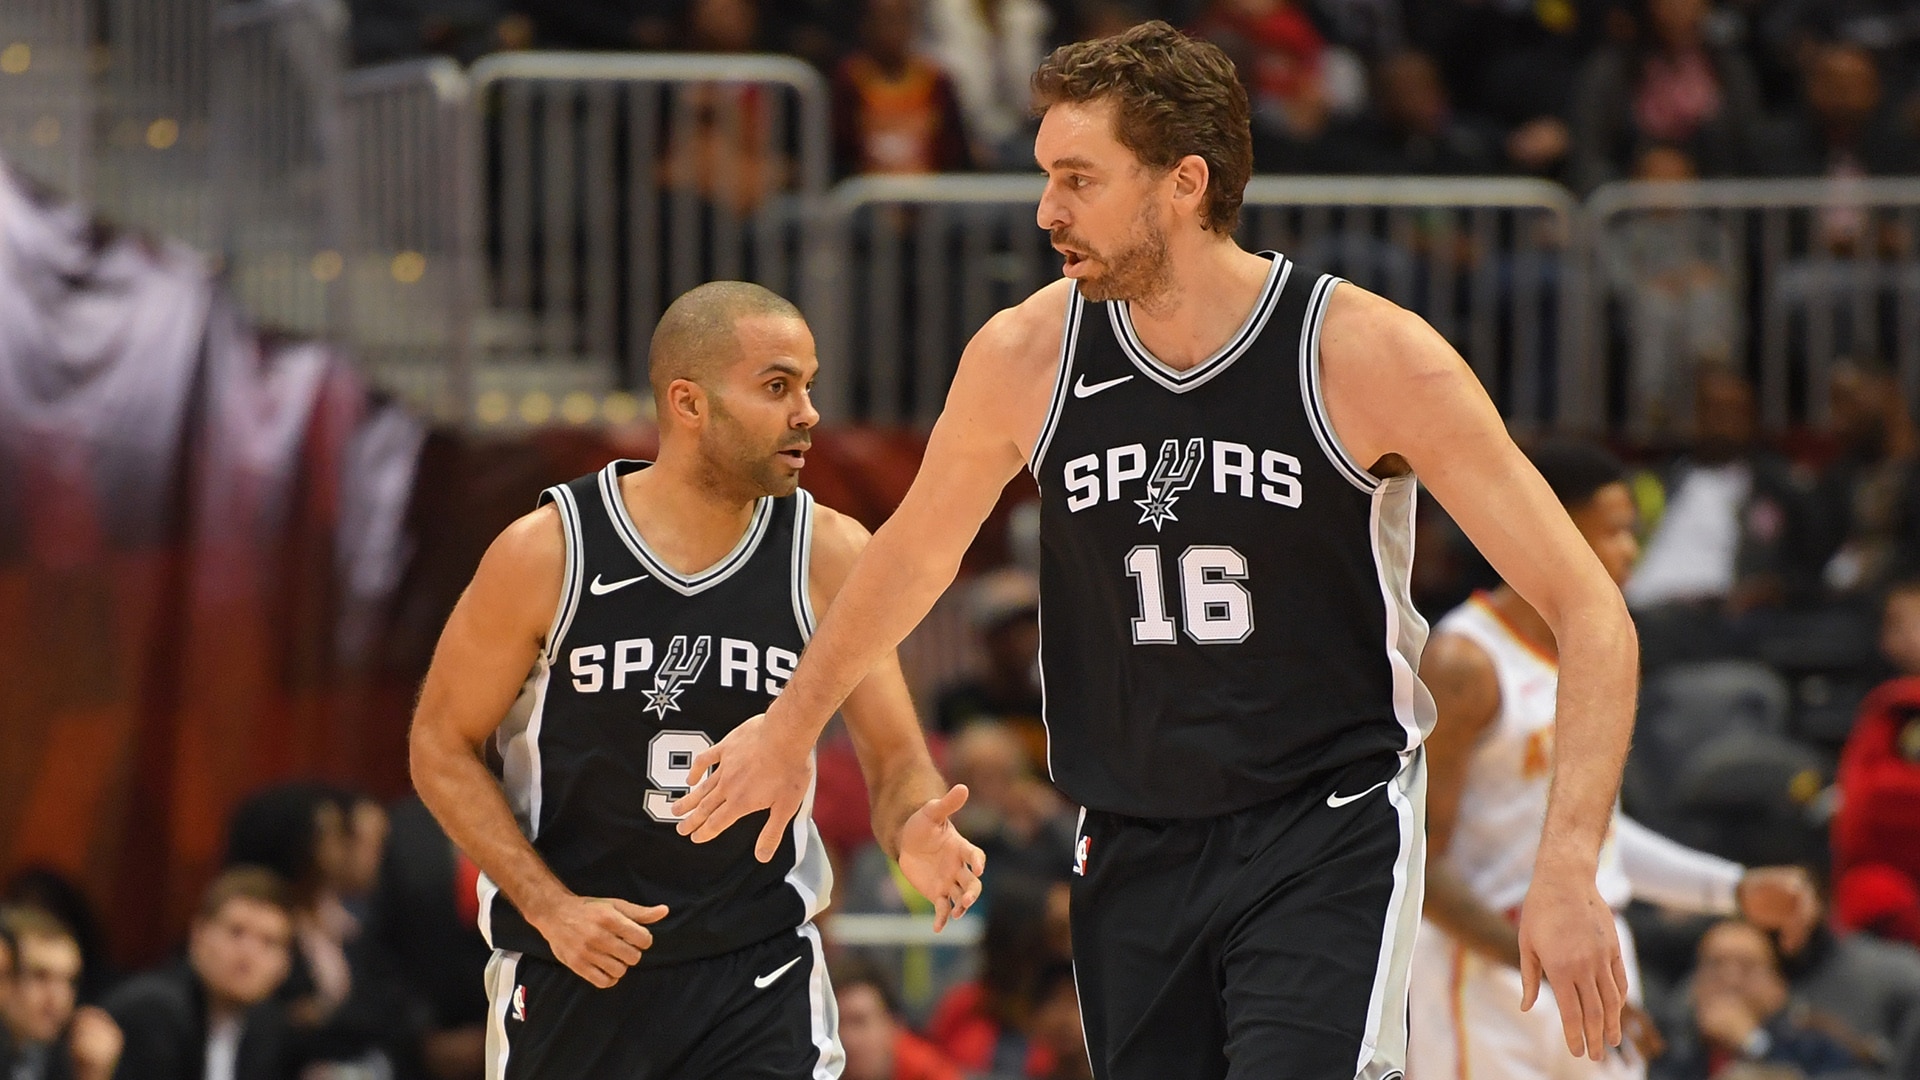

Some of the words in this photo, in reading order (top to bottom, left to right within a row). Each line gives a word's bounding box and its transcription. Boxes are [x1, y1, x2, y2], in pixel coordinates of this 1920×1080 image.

[1063, 437, 1303, 532] SPURS
[1124, 545, 1255, 645] 16
[569, 635, 799, 720] SPURS
[642, 729, 714, 823] 9
